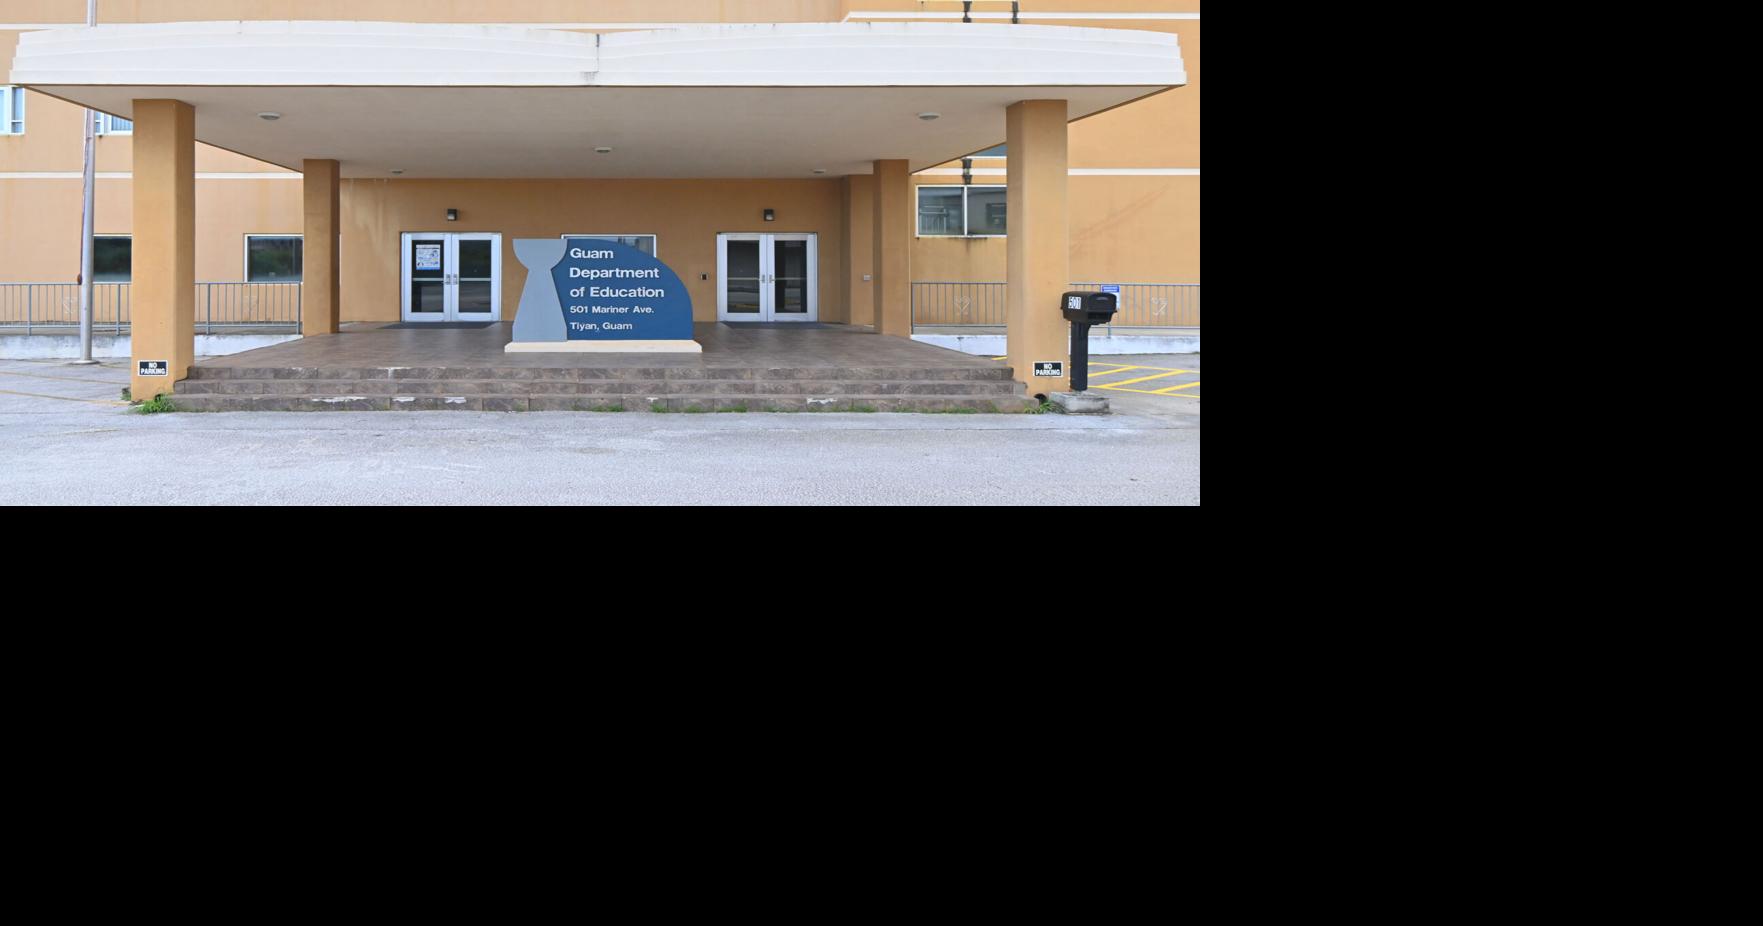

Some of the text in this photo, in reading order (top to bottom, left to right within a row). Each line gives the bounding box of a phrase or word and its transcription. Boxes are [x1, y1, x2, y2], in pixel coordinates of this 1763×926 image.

[570, 248, 614, 259] Guam
[569, 267, 660, 280] Department
[570, 286, 665, 298] of Education
[1068, 296, 1081, 309] 501
[570, 305, 654, 314] 501 Mariner Ave.
[570, 322, 633, 332] Tiyan, Guam
